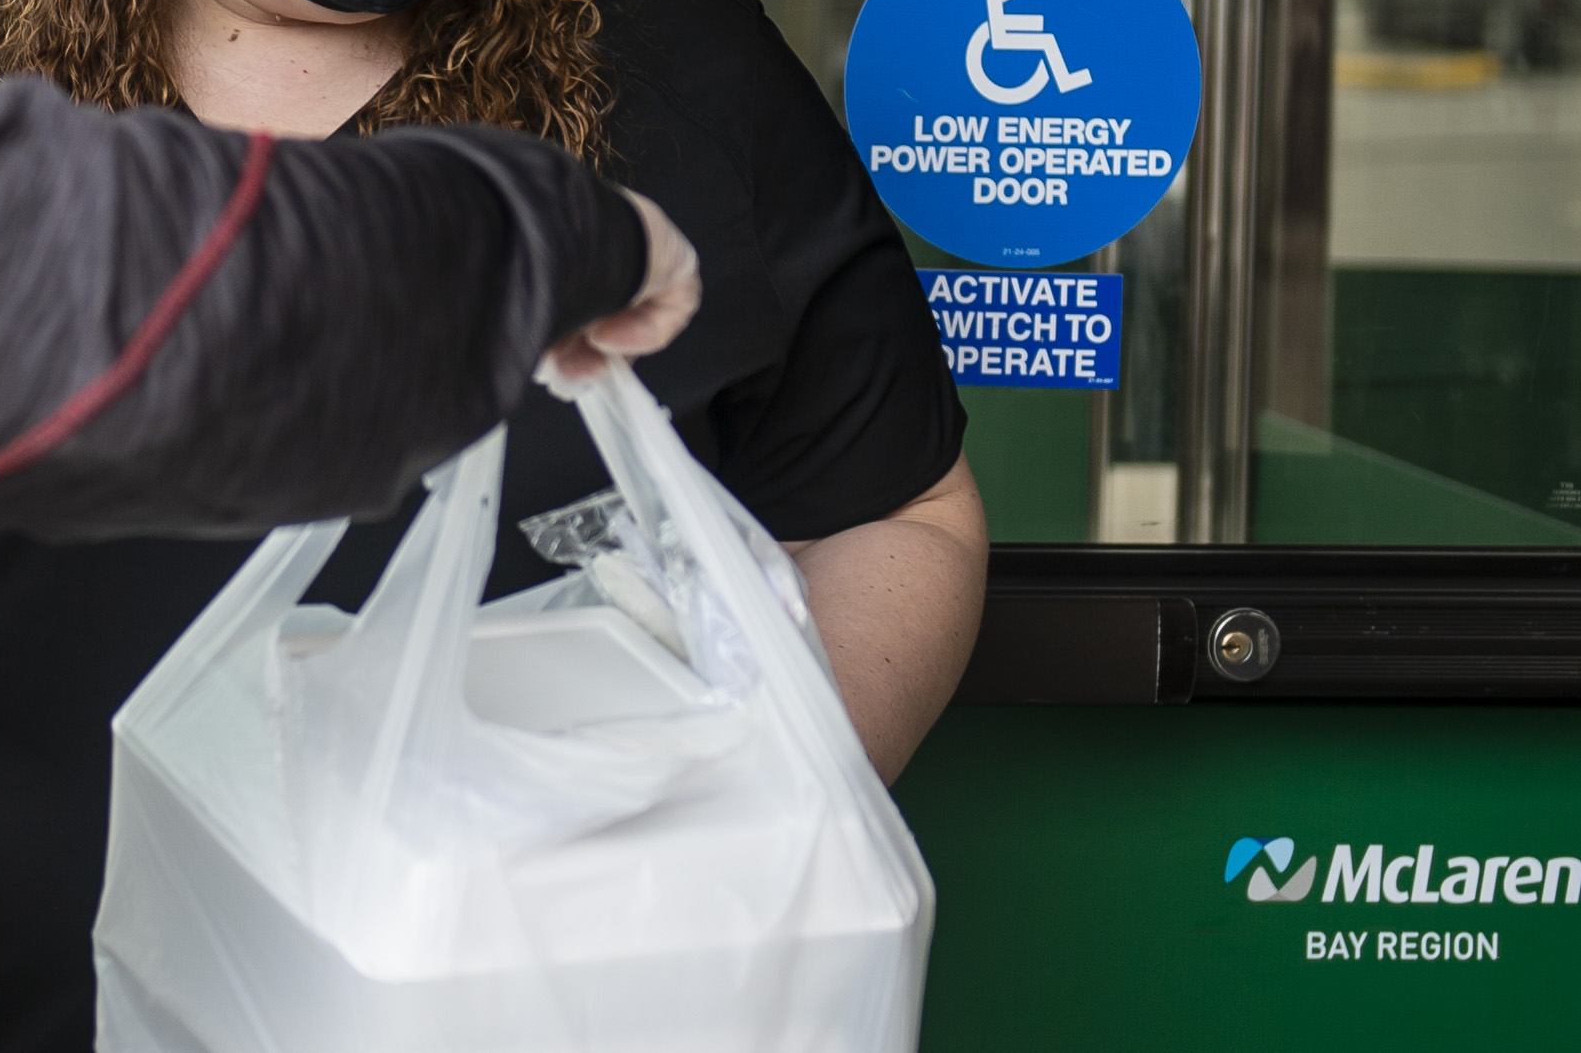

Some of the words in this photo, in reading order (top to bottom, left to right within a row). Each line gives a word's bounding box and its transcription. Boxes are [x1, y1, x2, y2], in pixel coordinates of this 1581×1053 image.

[914, 115, 989, 144] LOW
[997, 117, 1132, 147] ENERGY
[870, 145, 990, 174] POWER
[999, 147, 1172, 177] OPERATED
[972, 177, 1068, 206] DOOR
[928, 274, 1098, 308] ACTIVATE
[1064, 313, 1112, 344] TO
[1322, 843, 1581, 904] McLaren
[1306, 931, 1368, 960] BAY
[1377, 931, 1500, 960] REGION
